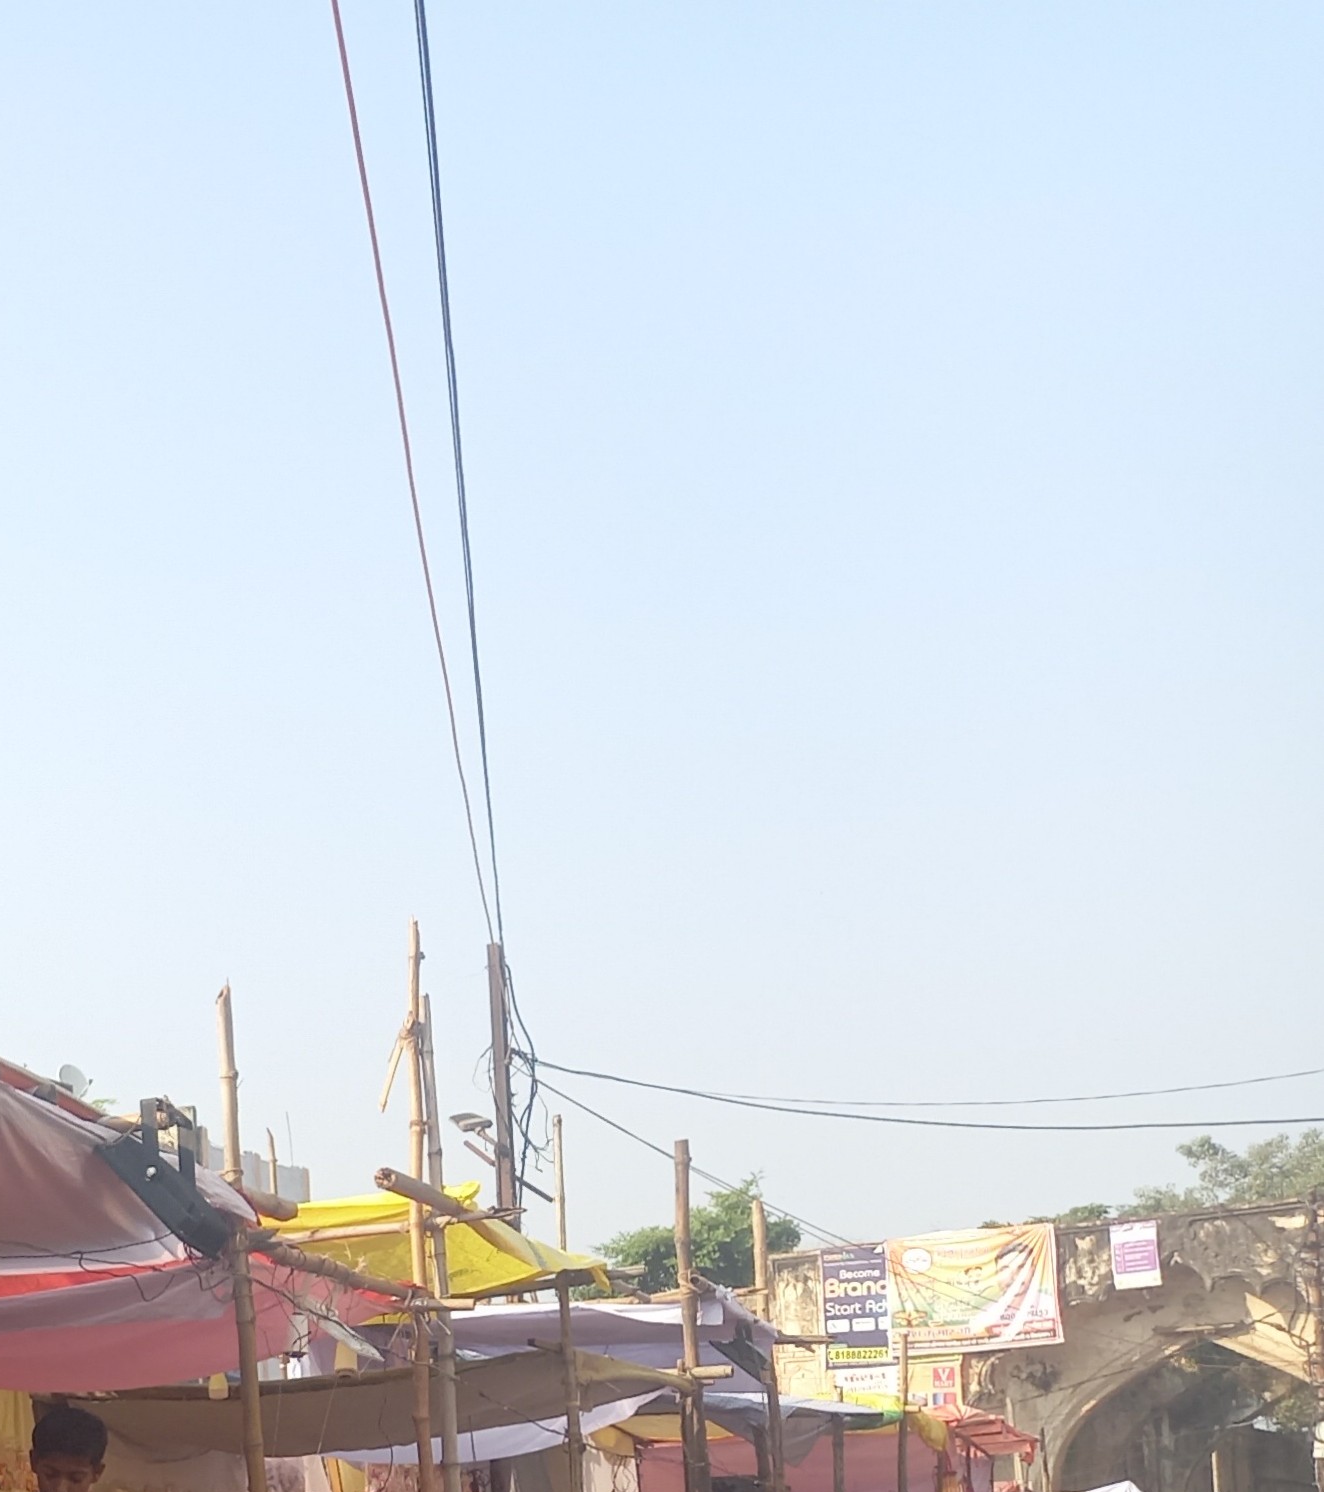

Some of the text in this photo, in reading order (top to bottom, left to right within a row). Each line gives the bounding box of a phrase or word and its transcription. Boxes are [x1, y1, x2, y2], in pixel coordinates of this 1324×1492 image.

[839, 1269, 881, 1279] Become
[825, 1299, 887, 1316] Start Ad
[937, 1367, 951, 1381] V
